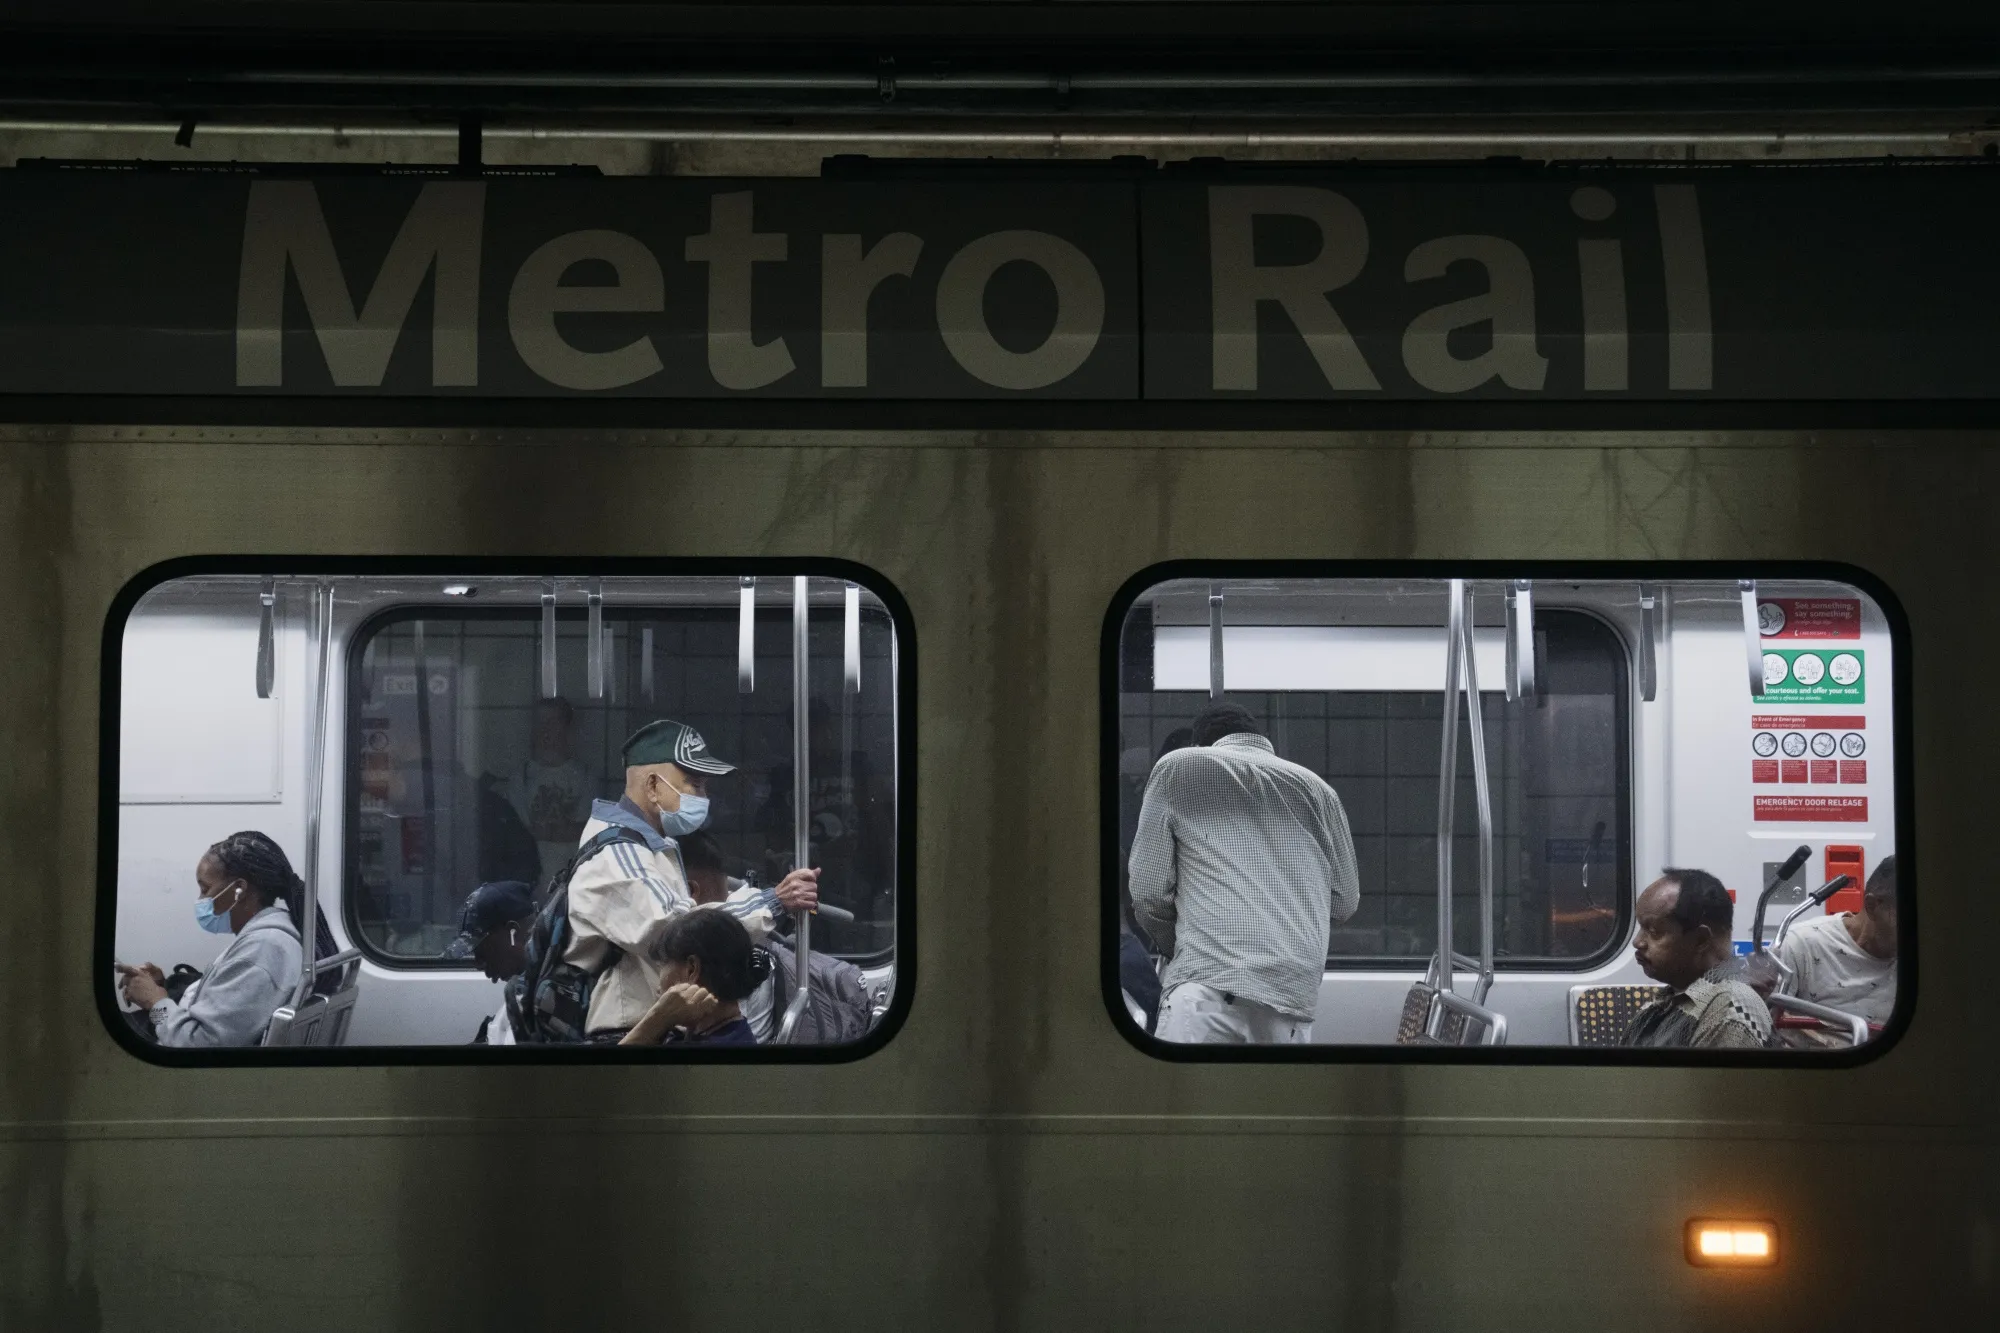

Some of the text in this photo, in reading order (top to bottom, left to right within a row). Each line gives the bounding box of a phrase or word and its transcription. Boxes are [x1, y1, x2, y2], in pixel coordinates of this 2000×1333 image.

[236, 180, 1713, 394] Metro Rail
[1795, 601, 1810, 610] See
[1795, 611, 1808, 620] say
[1766, 687, 1798, 695] courteous
[1799, 687, 1812, 695] and
[1812, 686, 1828, 695] offer
[1828, 687, 1843, 696] your
[1756, 798, 1863, 807] EMERGENCY DOOR RELEASE
